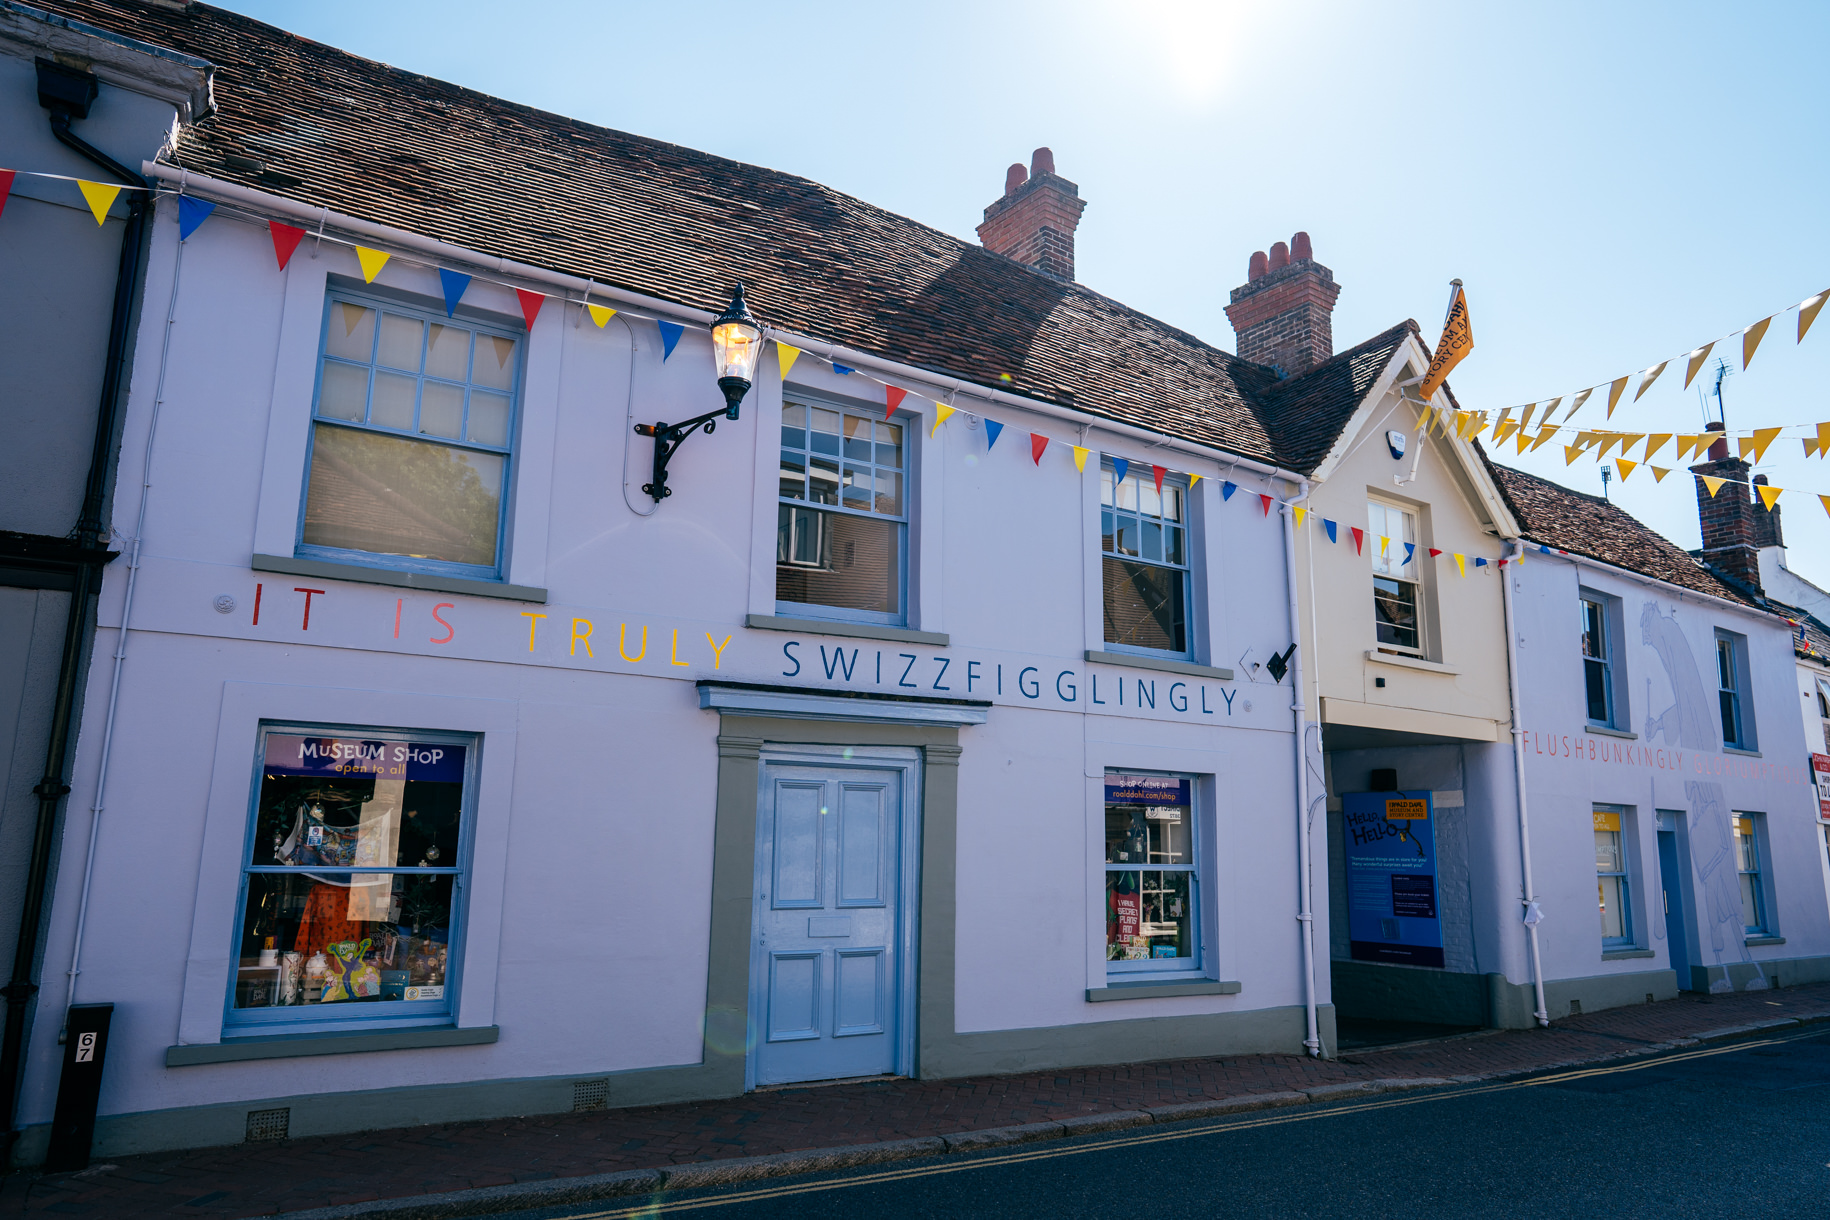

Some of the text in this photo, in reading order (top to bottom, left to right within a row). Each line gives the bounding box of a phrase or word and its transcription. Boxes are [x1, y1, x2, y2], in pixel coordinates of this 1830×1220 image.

[1423, 349, 1453, 385] STORY
[252, 583, 1237, 716] IT IS TRULY SWIZZFIGGLINGLY
[298, 742, 444, 764] MUSEUM SHOP
[1523, 730, 1808, 786] FLUSHBUNKINGLY GLORIUMPTIOUS
[334, 763, 406, 776] open to all
[1119, 780, 1137, 788] SHOP
[1137, 781, 1160, 789] ONLINE
[1820, 784, 1827, 797] TO
[1113, 789, 1176, 802] roalddahl.com/shop
[1346, 812, 1380, 827] HELLO,
[1351, 822, 1397, 846] HELLO
[1117, 907, 1139, 916] SECRET
[1119, 916, 1138, 925] PLANS
[1122, 925, 1133, 934] AND
